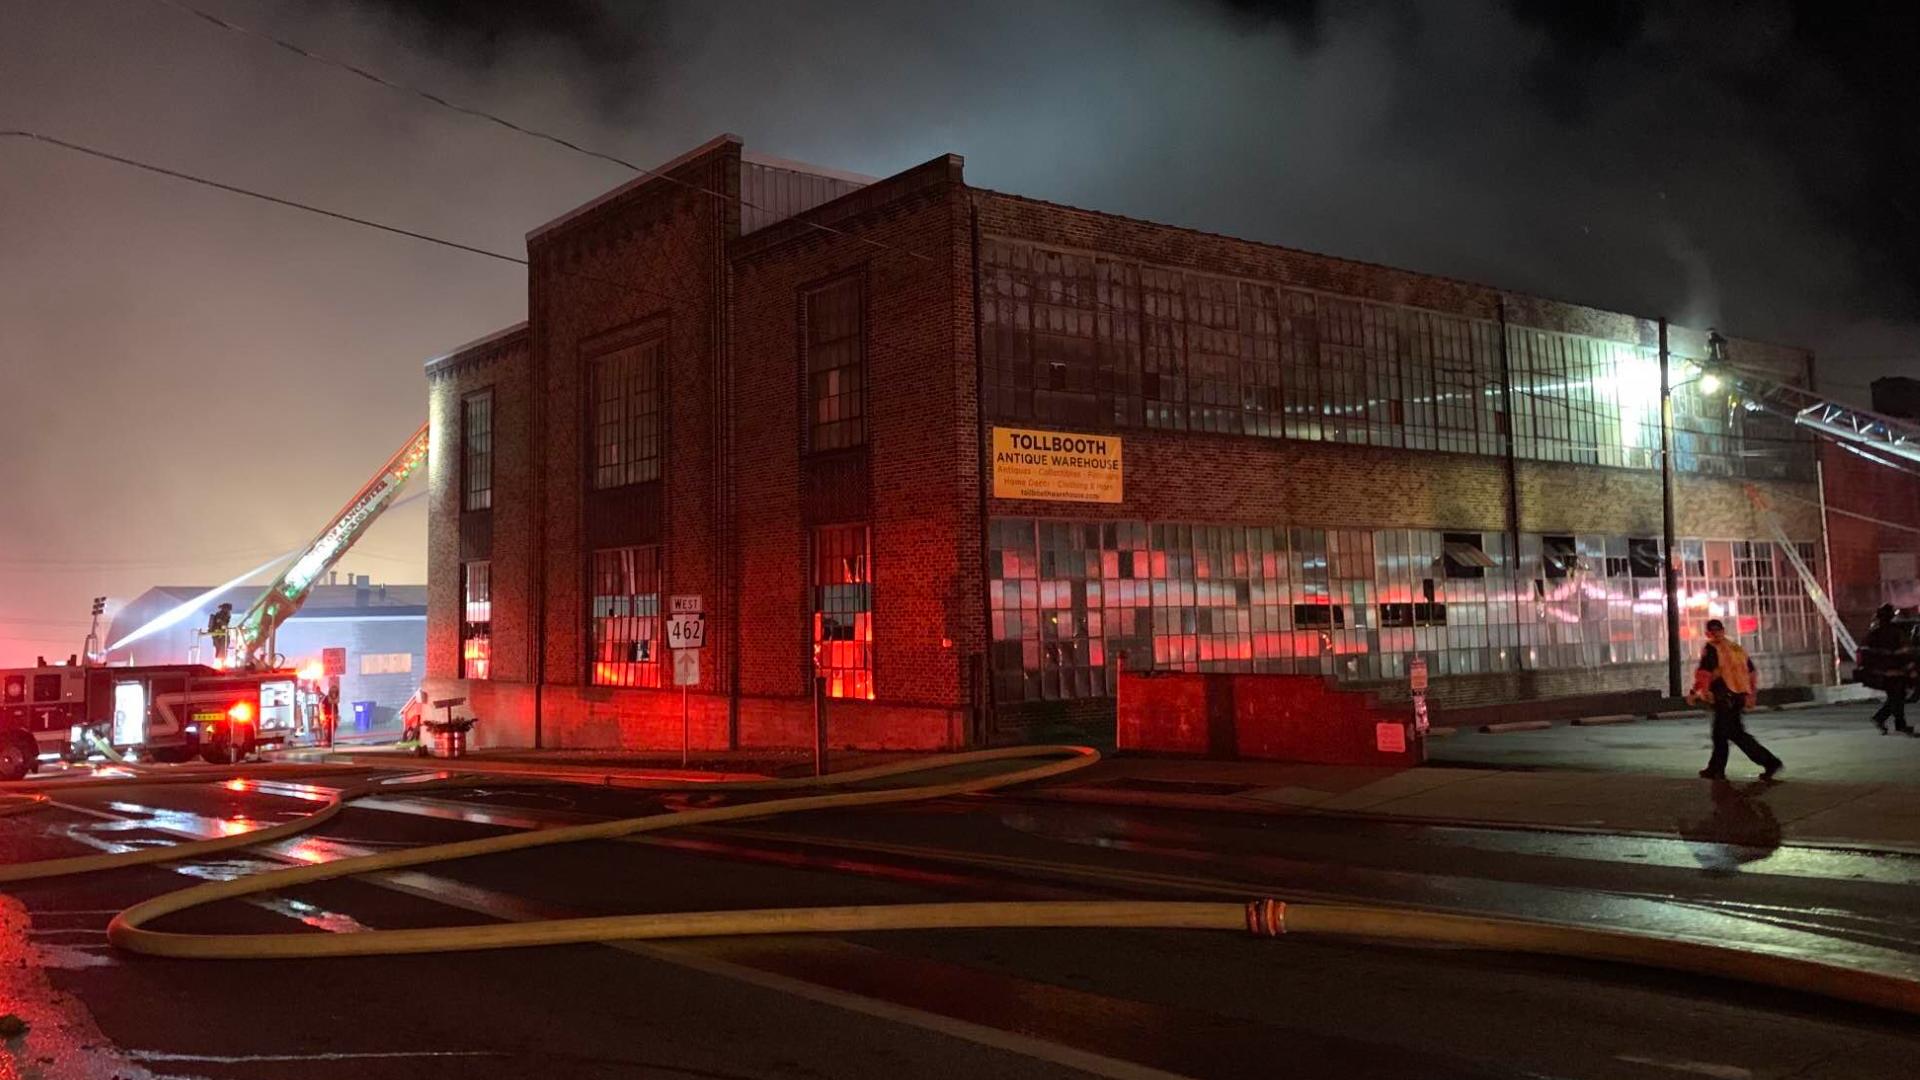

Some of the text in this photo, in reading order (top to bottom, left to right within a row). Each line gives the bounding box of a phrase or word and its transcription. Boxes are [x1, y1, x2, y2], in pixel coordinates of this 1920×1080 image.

[1010, 433, 1106, 455] TOLLBOOTH
[997, 452, 1119, 470] ANTIQUE WAREHOUSE
[339, 480, 388, 529] LANCASTER
[674, 598, 697, 610] WEST
[672, 620, 700, 640] 462
[41, 712, 49, 728] 1
